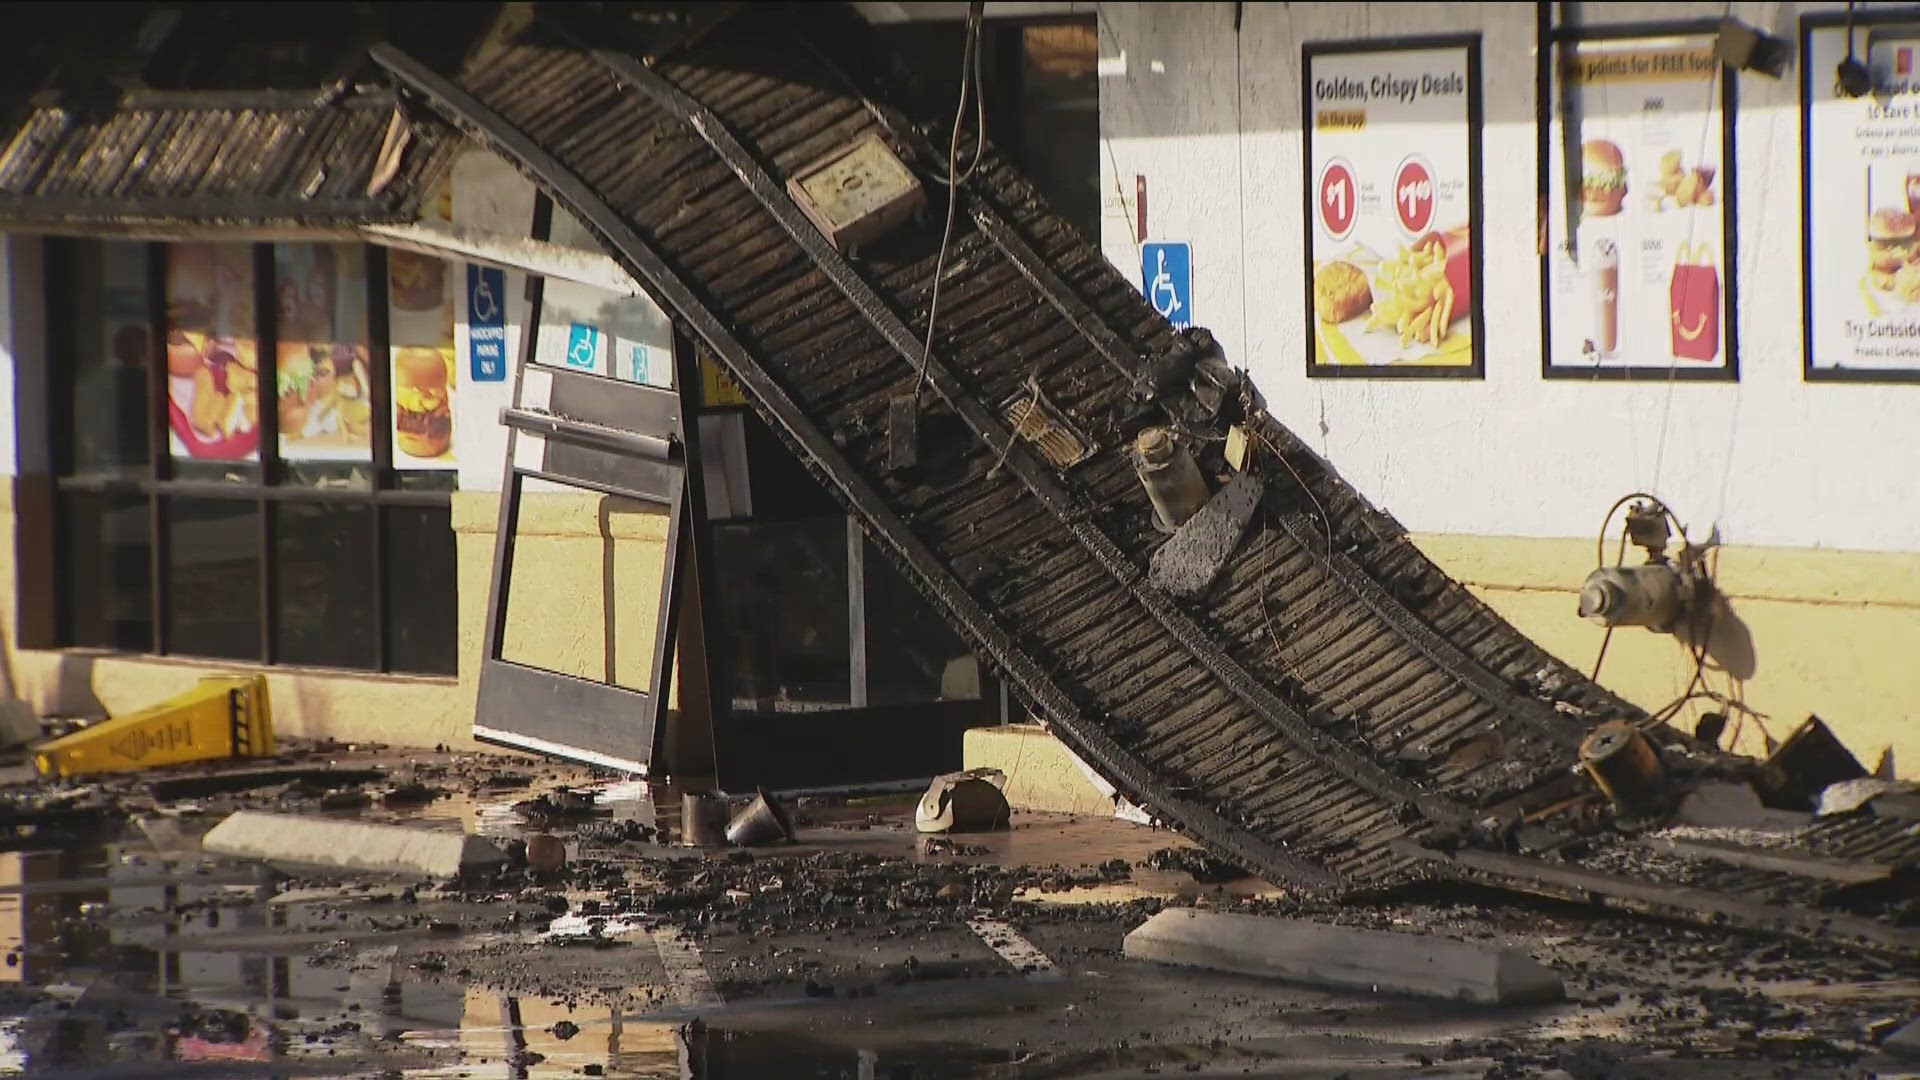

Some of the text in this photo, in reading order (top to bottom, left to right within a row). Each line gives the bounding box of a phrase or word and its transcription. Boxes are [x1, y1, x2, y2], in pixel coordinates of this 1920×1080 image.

[1588, 58, 1627, 81] points
[1632, 55, 1649, 73] for
[1654, 53, 1684, 72] FREE
[1316, 71, 1464, 102] Golden, Crispy Deals
[1330, 110, 1346, 127] the
[1347, 113, 1364, 130] app
[1846, 319, 1863, 342] Try
